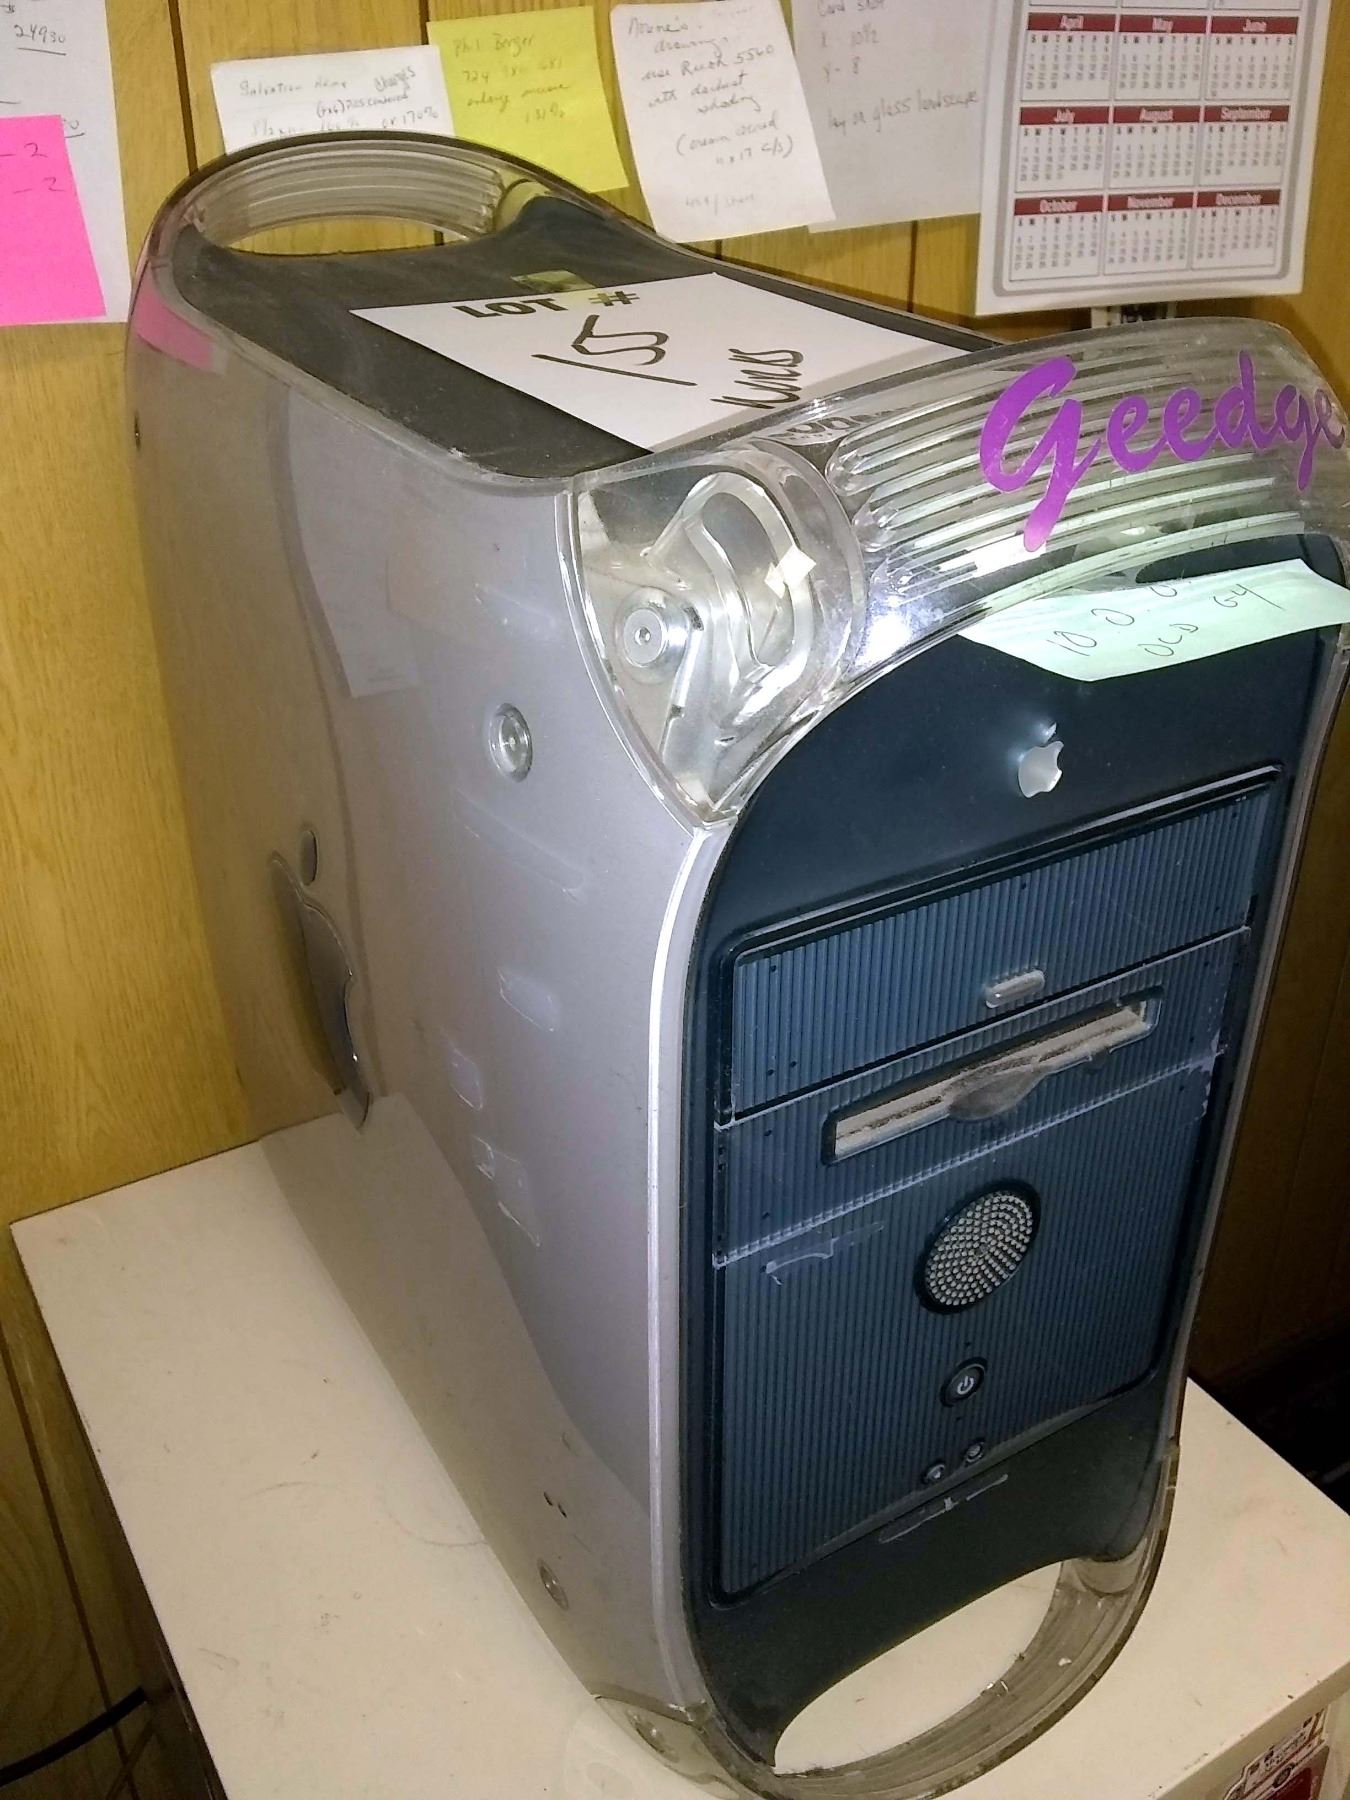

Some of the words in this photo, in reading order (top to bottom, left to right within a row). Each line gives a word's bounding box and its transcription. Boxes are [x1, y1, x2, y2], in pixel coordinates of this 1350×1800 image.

[1243, 19, 1267, 32] June
[1054, 109, 1076, 125] July
[1139, 107, 1174, 122] August
[1220, 106, 1272, 122] September
[1039, 199, 1078, 214] October
[1127, 195, 1174, 209] November
[1215, 193, 1262, 207] December
[452, 298, 568, 318] LOT
[588, 290, 640, 308] #
[979, 349, 1346, 552] Geedge
